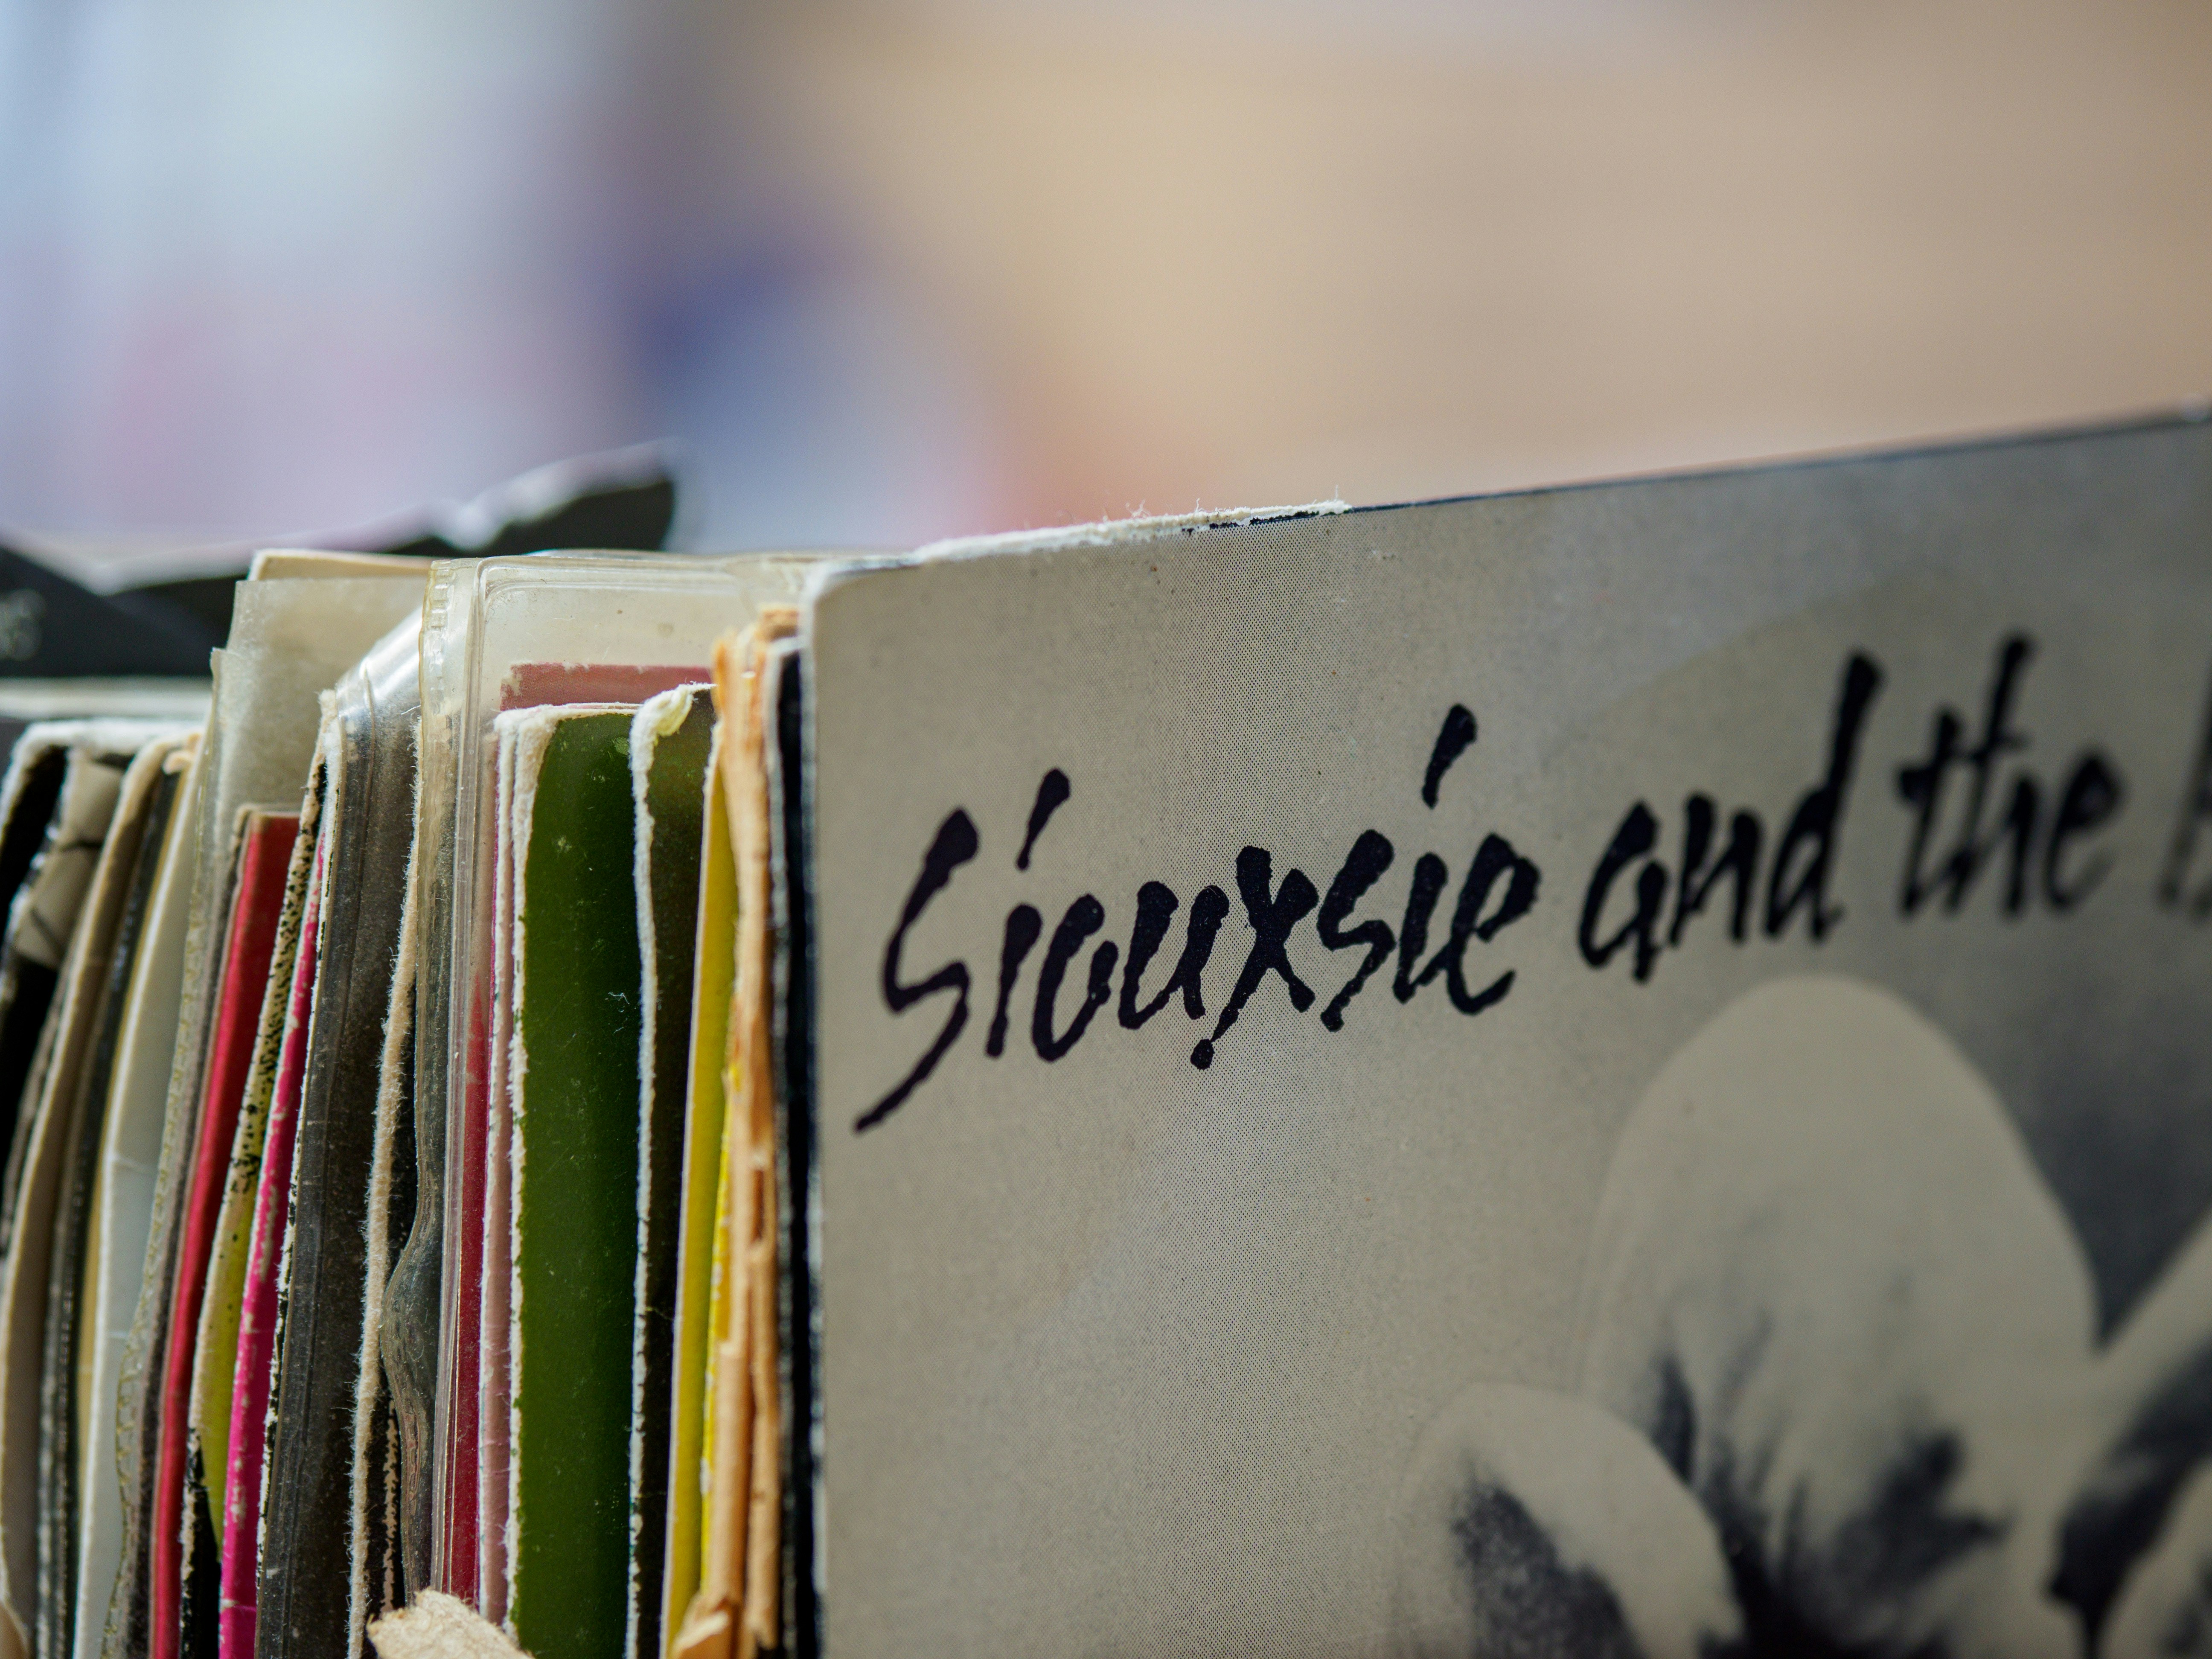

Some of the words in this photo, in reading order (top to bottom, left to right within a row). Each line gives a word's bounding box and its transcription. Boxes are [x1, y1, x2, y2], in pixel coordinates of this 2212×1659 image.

[853, 704, 1540, 1132] Siouxsie
[1578, 650, 1883, 983] and
[1897, 633, 2122, 920] the
